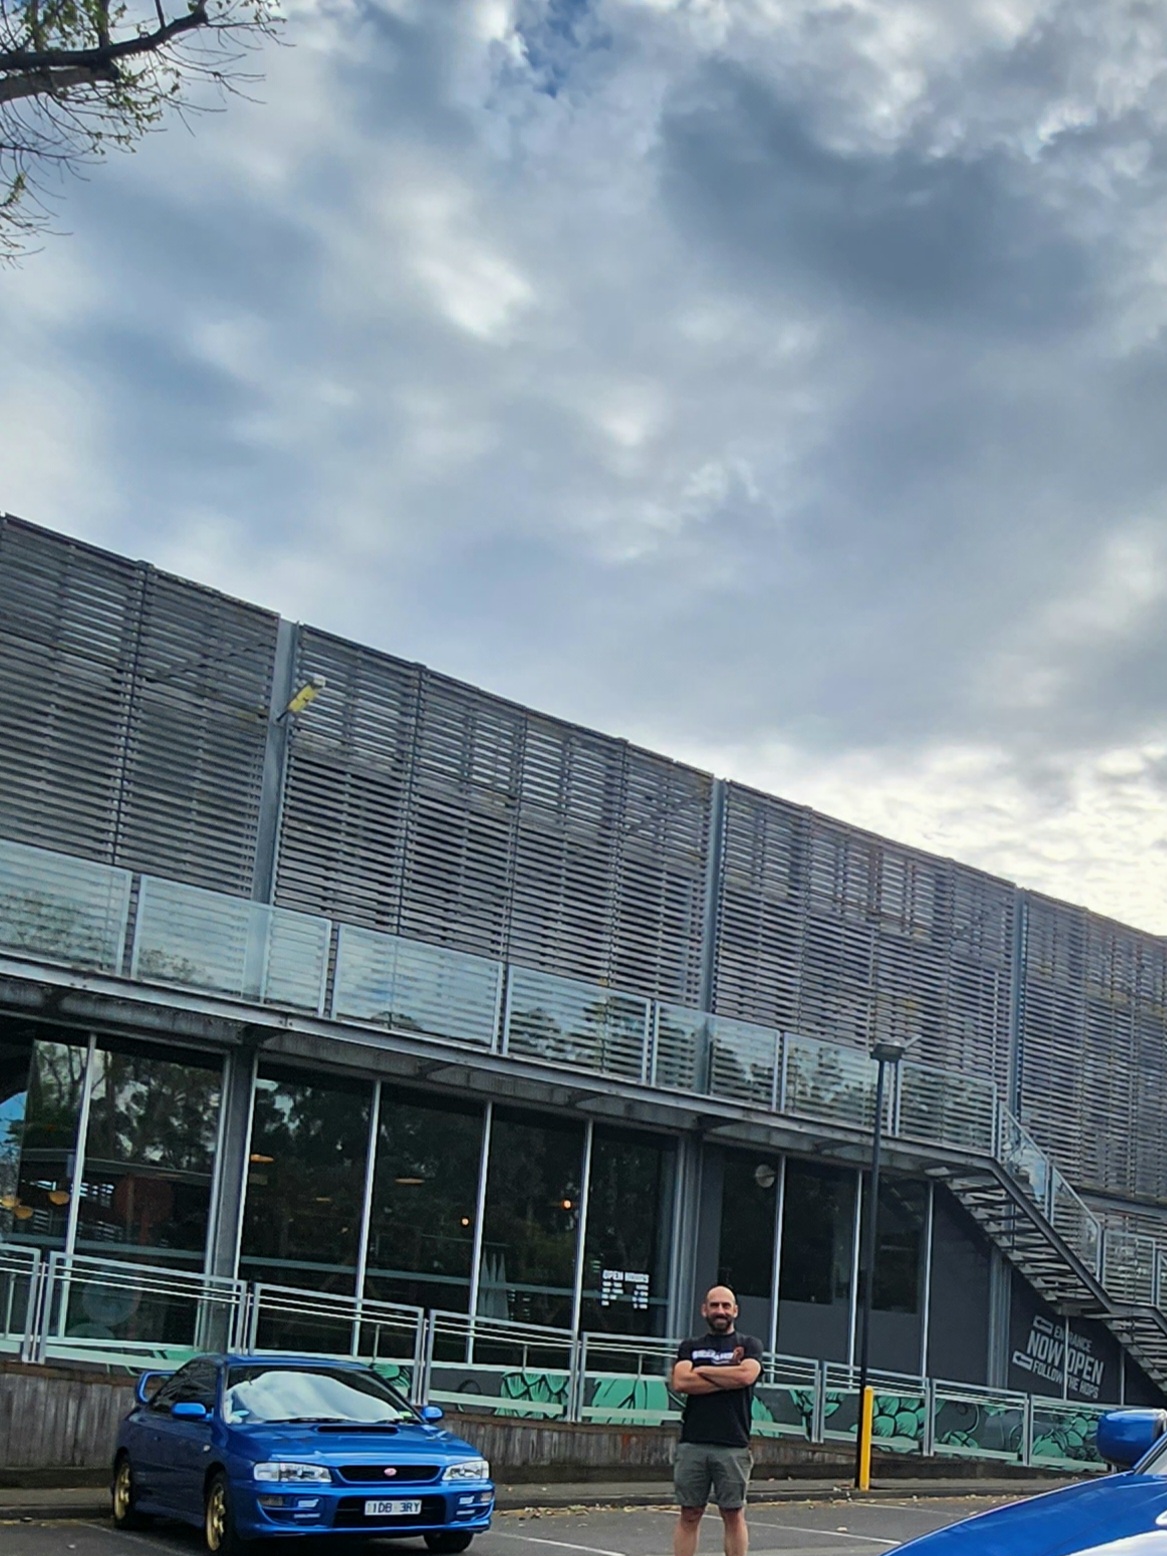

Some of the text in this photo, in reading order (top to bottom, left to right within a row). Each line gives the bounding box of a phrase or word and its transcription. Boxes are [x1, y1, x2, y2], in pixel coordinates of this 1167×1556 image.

[1026, 1329, 1104, 1385] NOW OPEN
[1054, 1325, 1093, 1353] ENRANCE
